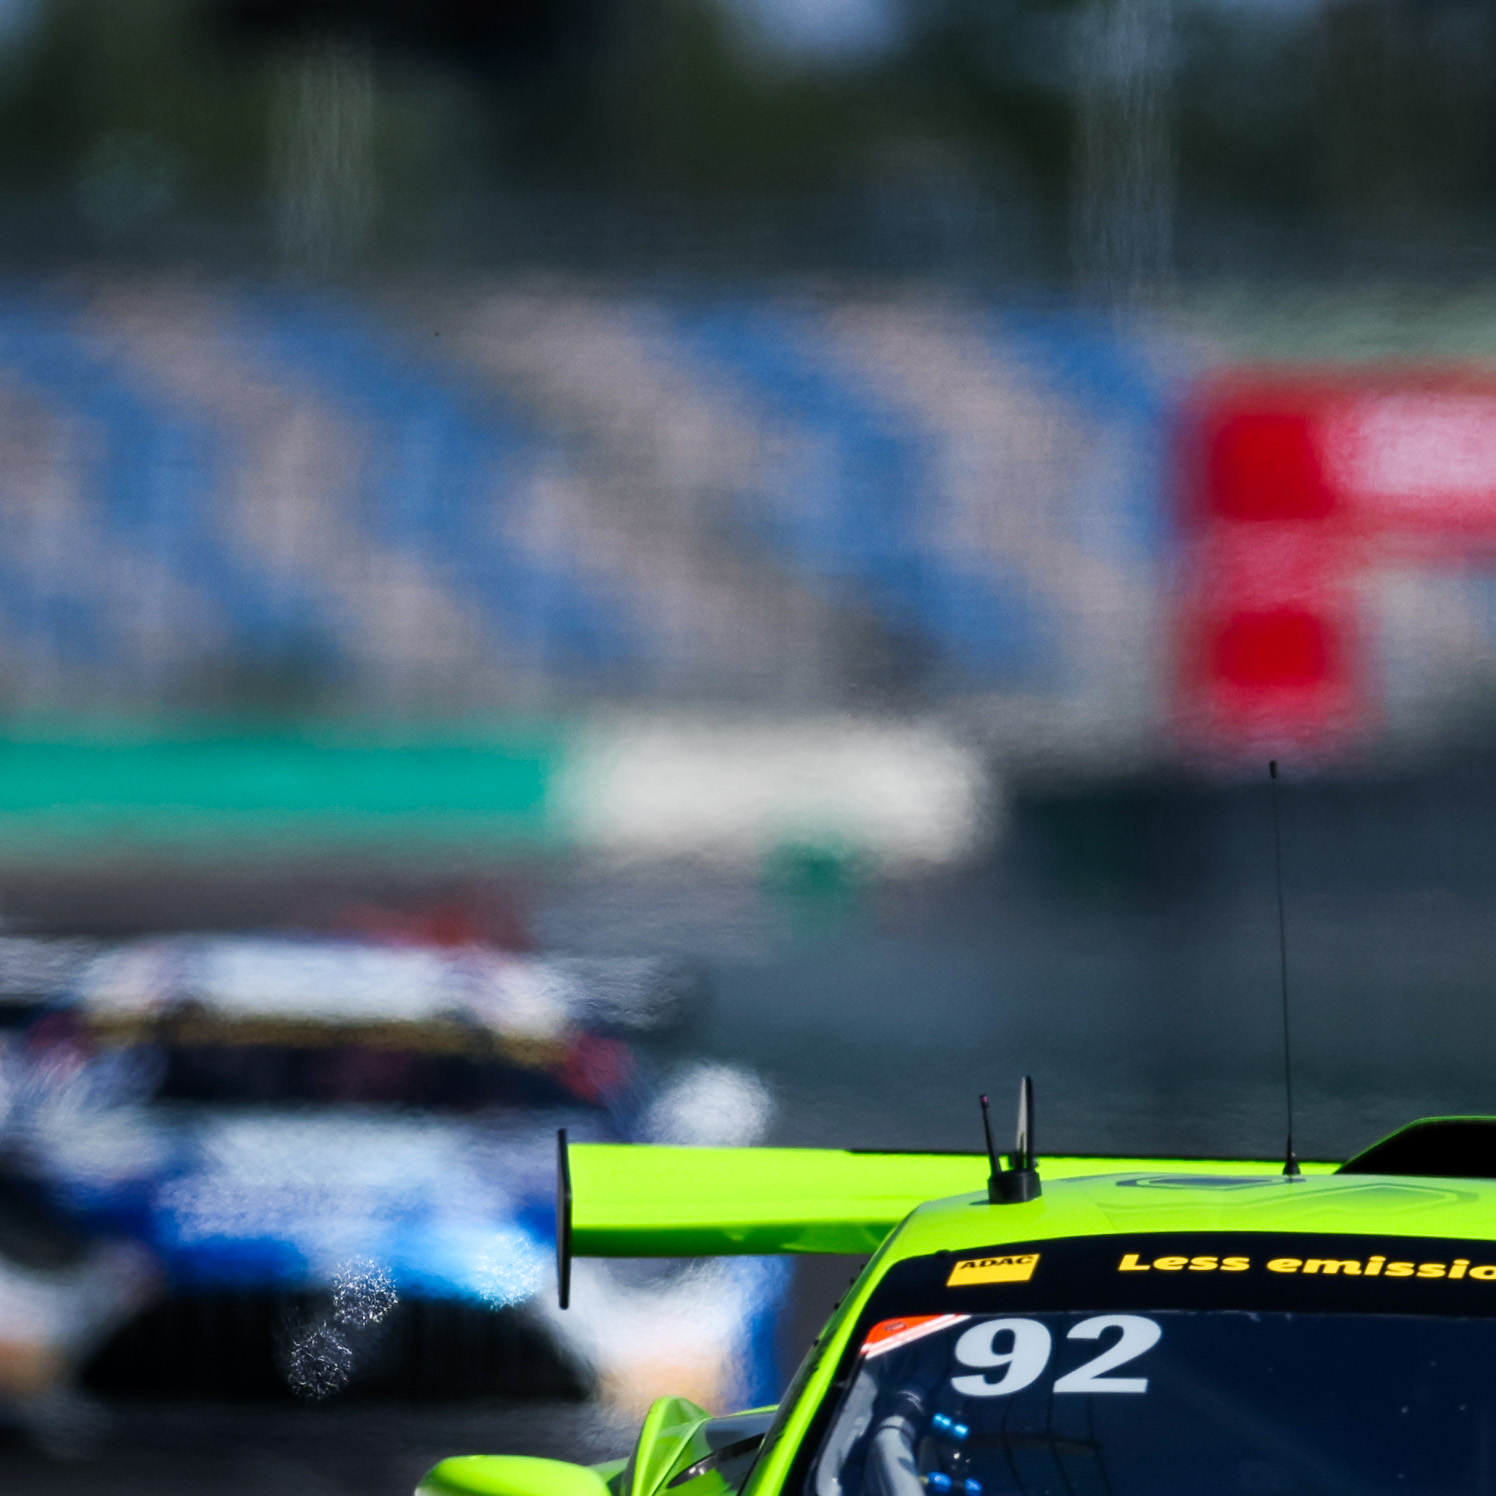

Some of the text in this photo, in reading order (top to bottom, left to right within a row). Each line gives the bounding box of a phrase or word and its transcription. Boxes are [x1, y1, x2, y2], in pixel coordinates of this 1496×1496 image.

[957, 1255, 1033, 1270] ADAC
[1118, 1254, 1250, 1271] Less
[951, 1314, 1161, 1397] 92
